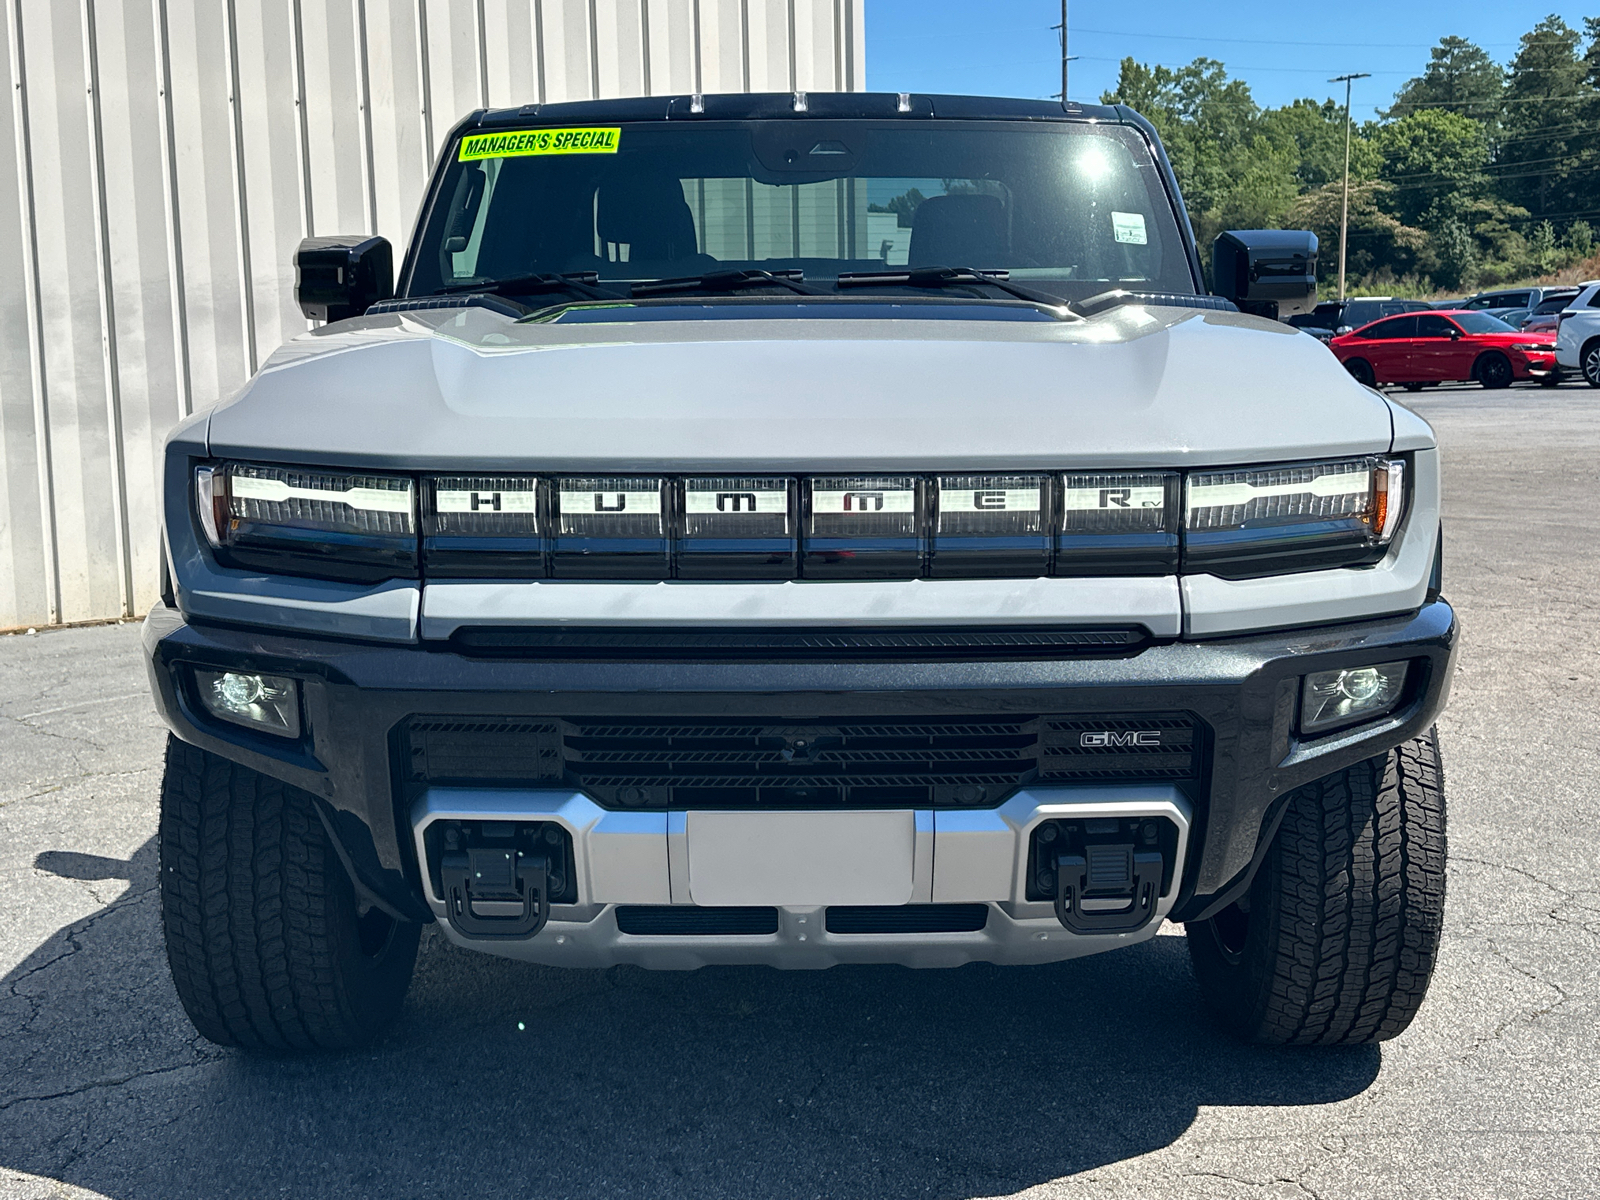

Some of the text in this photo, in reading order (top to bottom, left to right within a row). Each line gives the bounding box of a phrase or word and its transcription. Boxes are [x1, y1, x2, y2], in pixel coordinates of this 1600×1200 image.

[464, 131, 614, 156] MANAGER'S SPECIAL
[470, 489, 1162, 511] HUMMER EV
[1080, 730, 1161, 747] GMC
